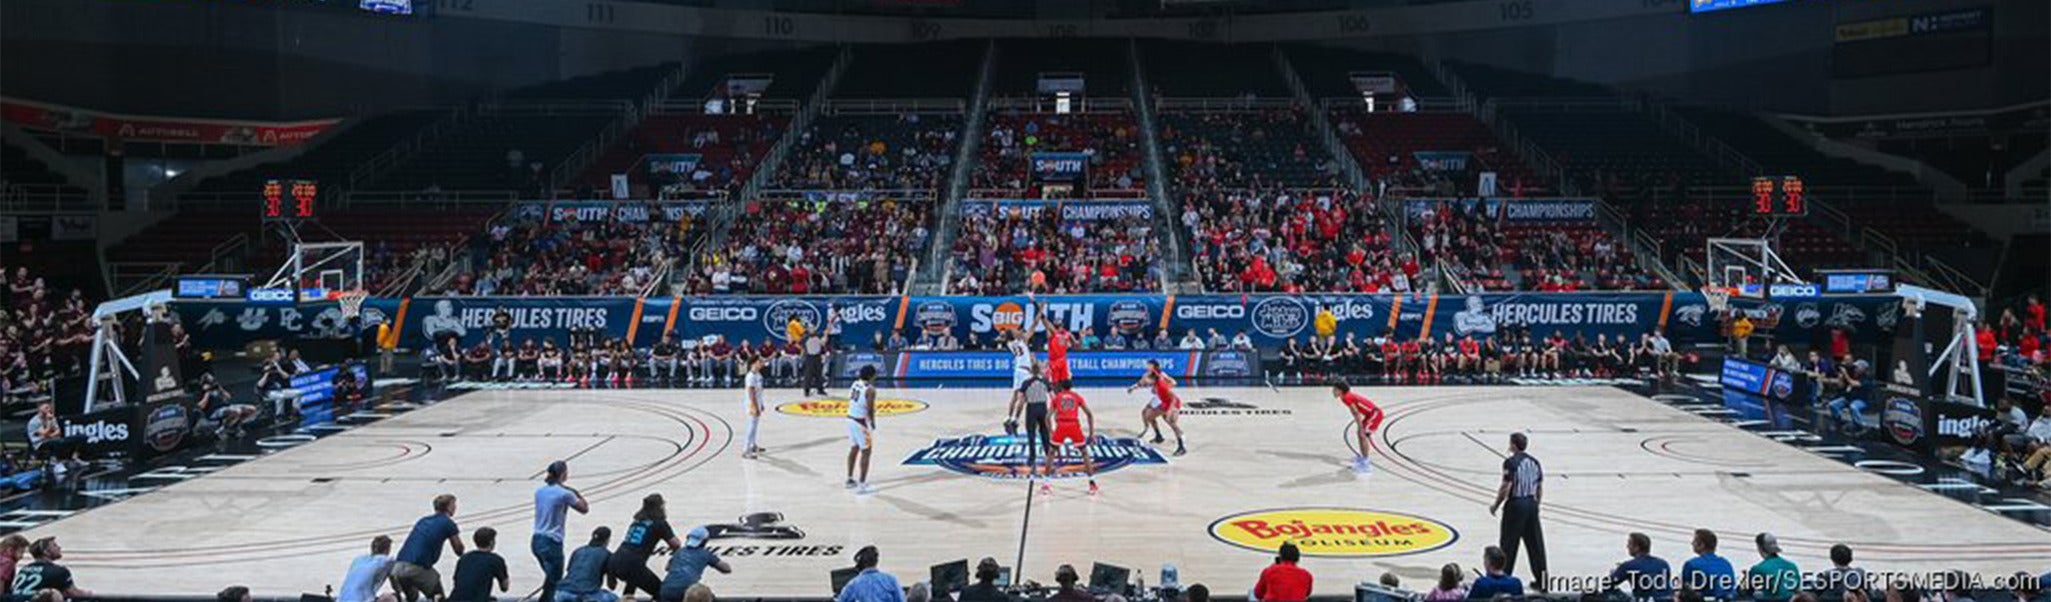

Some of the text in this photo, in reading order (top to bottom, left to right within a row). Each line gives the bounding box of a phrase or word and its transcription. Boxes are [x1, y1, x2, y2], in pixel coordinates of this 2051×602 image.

[586, 3, 614, 23] 111
[766, 18, 793, 35] 110
[1063, 204, 1151, 220] CHAMPIONSHIPS
[251, 289, 294, 301] GEICO
[1770, 285, 1816, 297] GEICO
[461, 308, 608, 329] HERULES TIRES
[690, 307, 758, 321] GEICO
[992, 311, 1024, 325] BIG
[1177, 305, 1243, 319] GEICO
[1492, 303, 1638, 324] HERCULES TIRES
[920, 358, 1010, 370] HERCULES TIRES BIG
[64, 420, 130, 443] ingles
[1231, 519, 1432, 541] Bojangles
[764, 546, 844, 556] TIRES
[11, 573, 42, 595] 22
